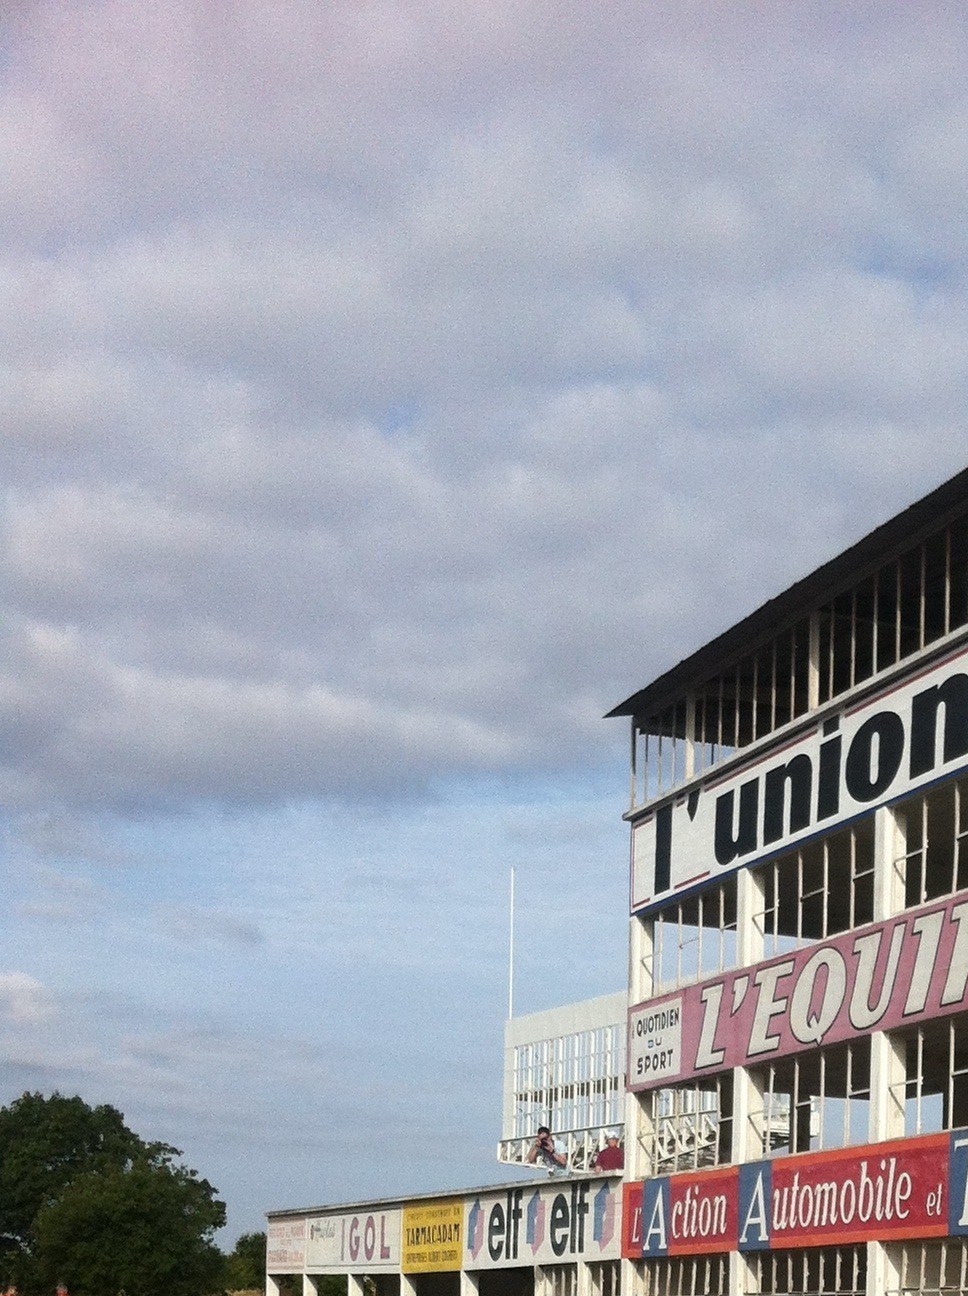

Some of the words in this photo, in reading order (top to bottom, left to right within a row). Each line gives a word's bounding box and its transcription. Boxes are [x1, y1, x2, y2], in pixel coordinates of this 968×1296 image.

[635, 1007, 681, 1037] QUOTIDIEN
[647, 1036, 663, 1050] DU
[636, 1049, 675, 1076] SPORT
[739, 1157, 912, 1246] Automobile
[926, 1181, 944, 1218] et
[406, 1223, 460, 1246] TARMACADAM
[488, 1189, 524, 1263] elf
[550, 1182, 590, 1257] elf
[340, 1215, 391, 1263] IGOL
